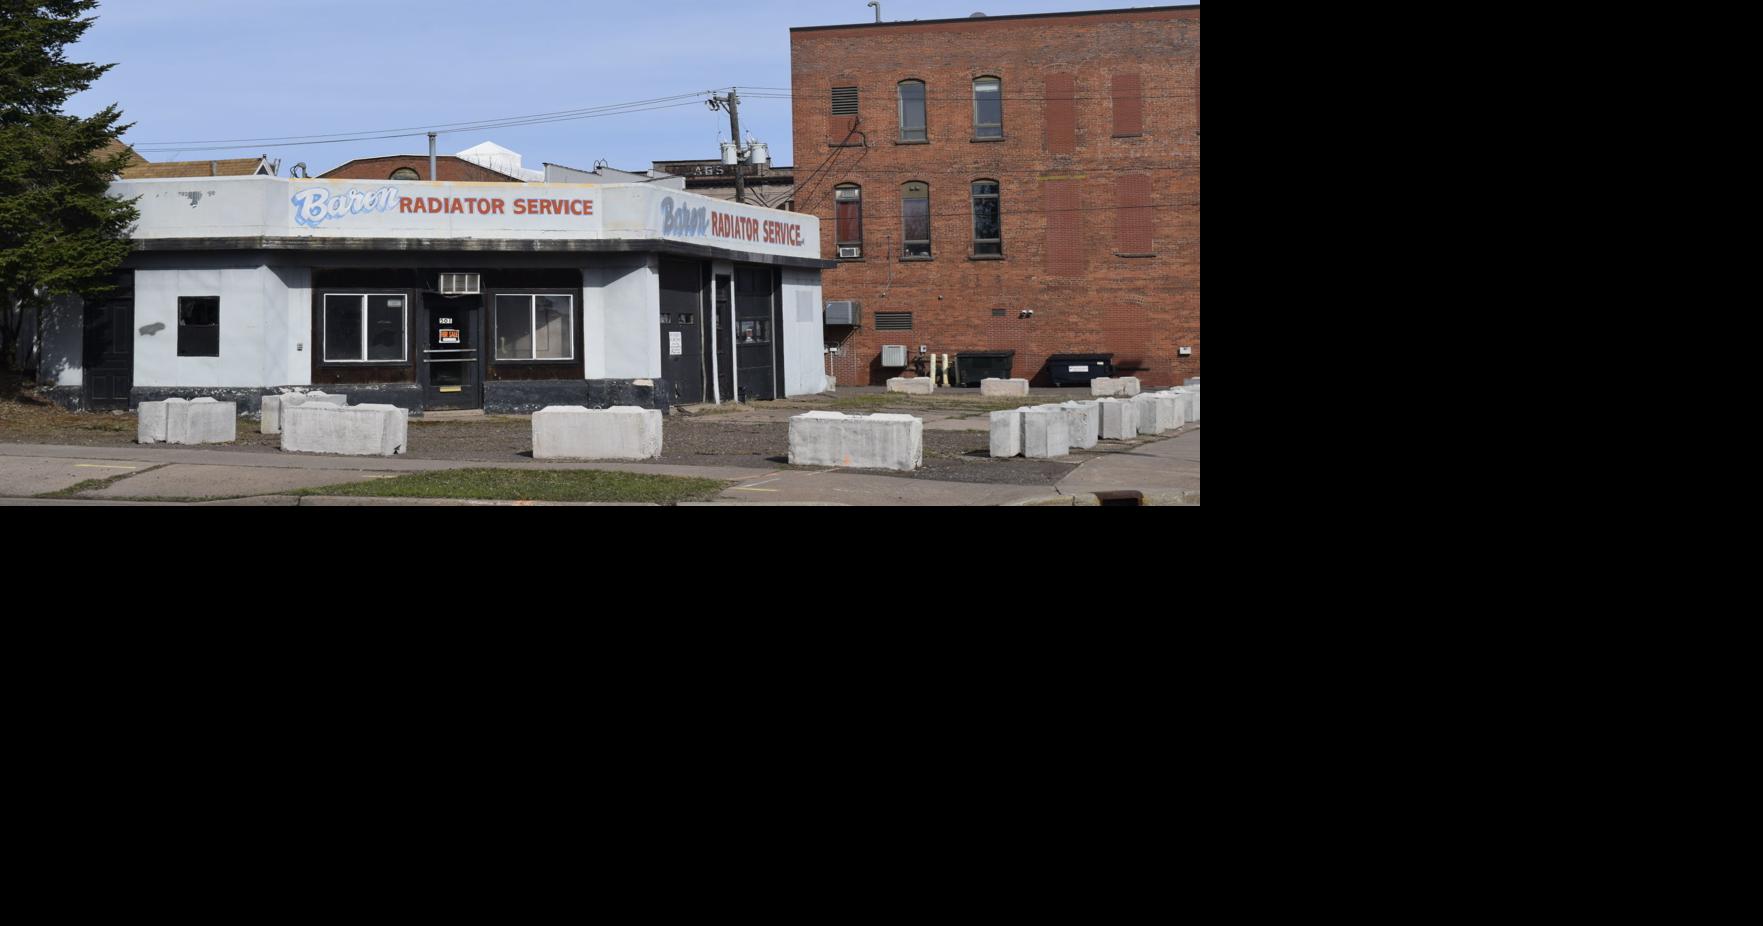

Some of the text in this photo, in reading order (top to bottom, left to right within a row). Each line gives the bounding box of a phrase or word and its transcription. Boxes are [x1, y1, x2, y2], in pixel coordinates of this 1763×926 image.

[291, 185, 593, 228] Baron RADIATOR SERVICE
[711, 211, 759, 242] RADIATOR
[763, 219, 801, 246] SERVICE
